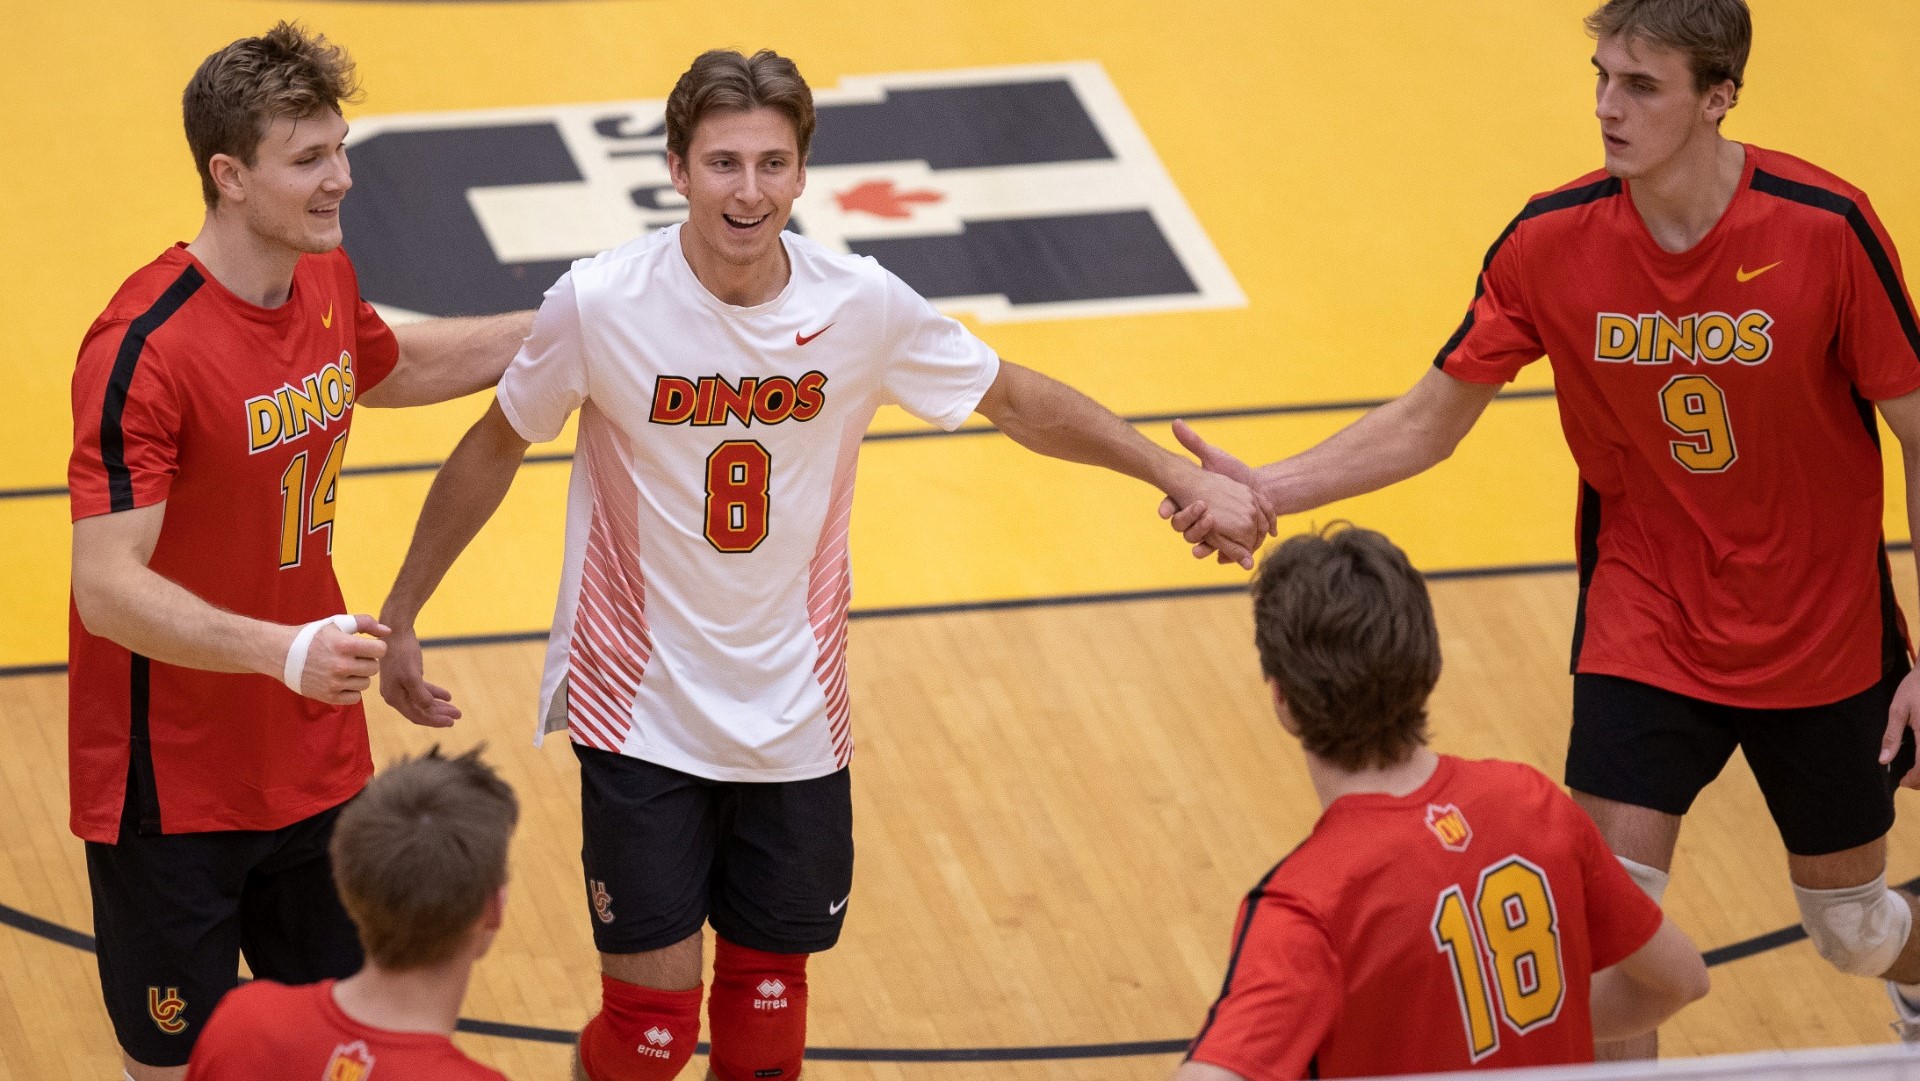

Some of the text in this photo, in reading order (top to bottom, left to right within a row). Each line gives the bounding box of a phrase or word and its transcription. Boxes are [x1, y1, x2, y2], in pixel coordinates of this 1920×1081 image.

[1595, 310, 1774, 366] DINOS
[245, 350, 355, 455] DINOS
[649, 370, 828, 428] DINOS
[1658, 374, 1738, 473] 9
[279, 429, 347, 570] 14
[703, 440, 772, 554] 8
[1431, 854, 1566, 1064] 18
